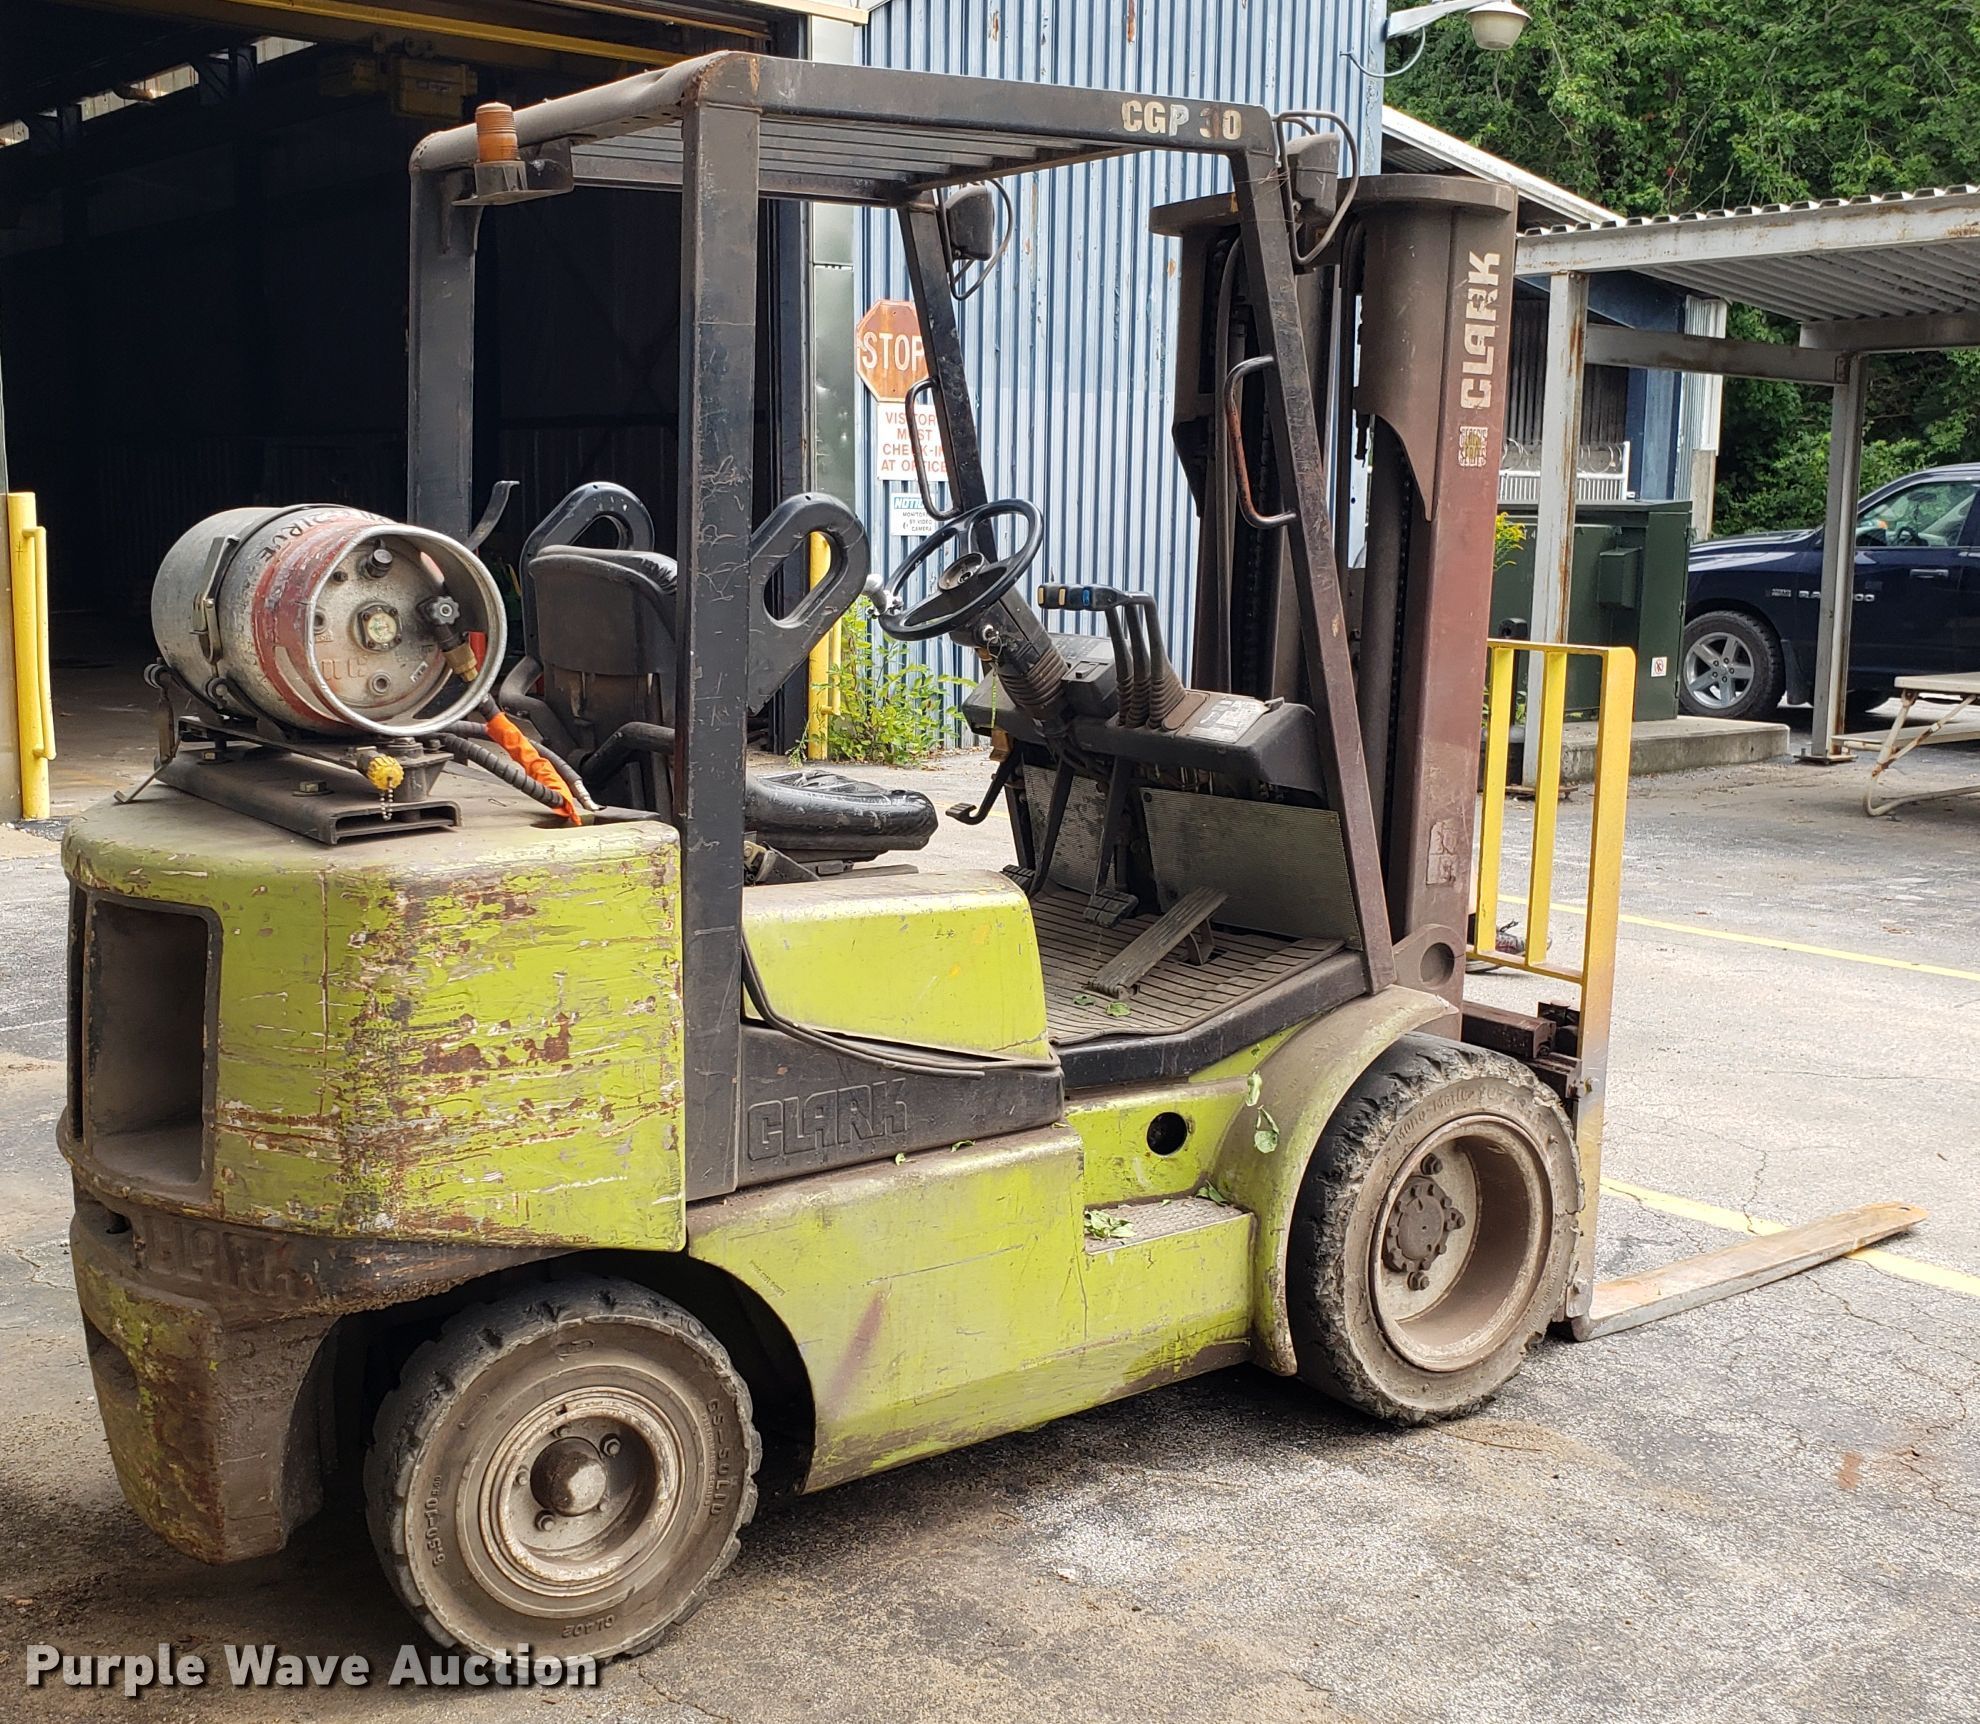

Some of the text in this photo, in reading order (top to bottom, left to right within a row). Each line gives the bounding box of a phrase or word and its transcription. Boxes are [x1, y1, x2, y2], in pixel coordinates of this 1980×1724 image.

[1121, 99, 1189, 136] CGP
[1460, 250, 1501, 410] CLARK
[861, 331, 926, 371] STOP
[896, 428, 933, 441] MST
[881, 459, 896, 472] AT
[748, 1076, 908, 1161] CLARK
